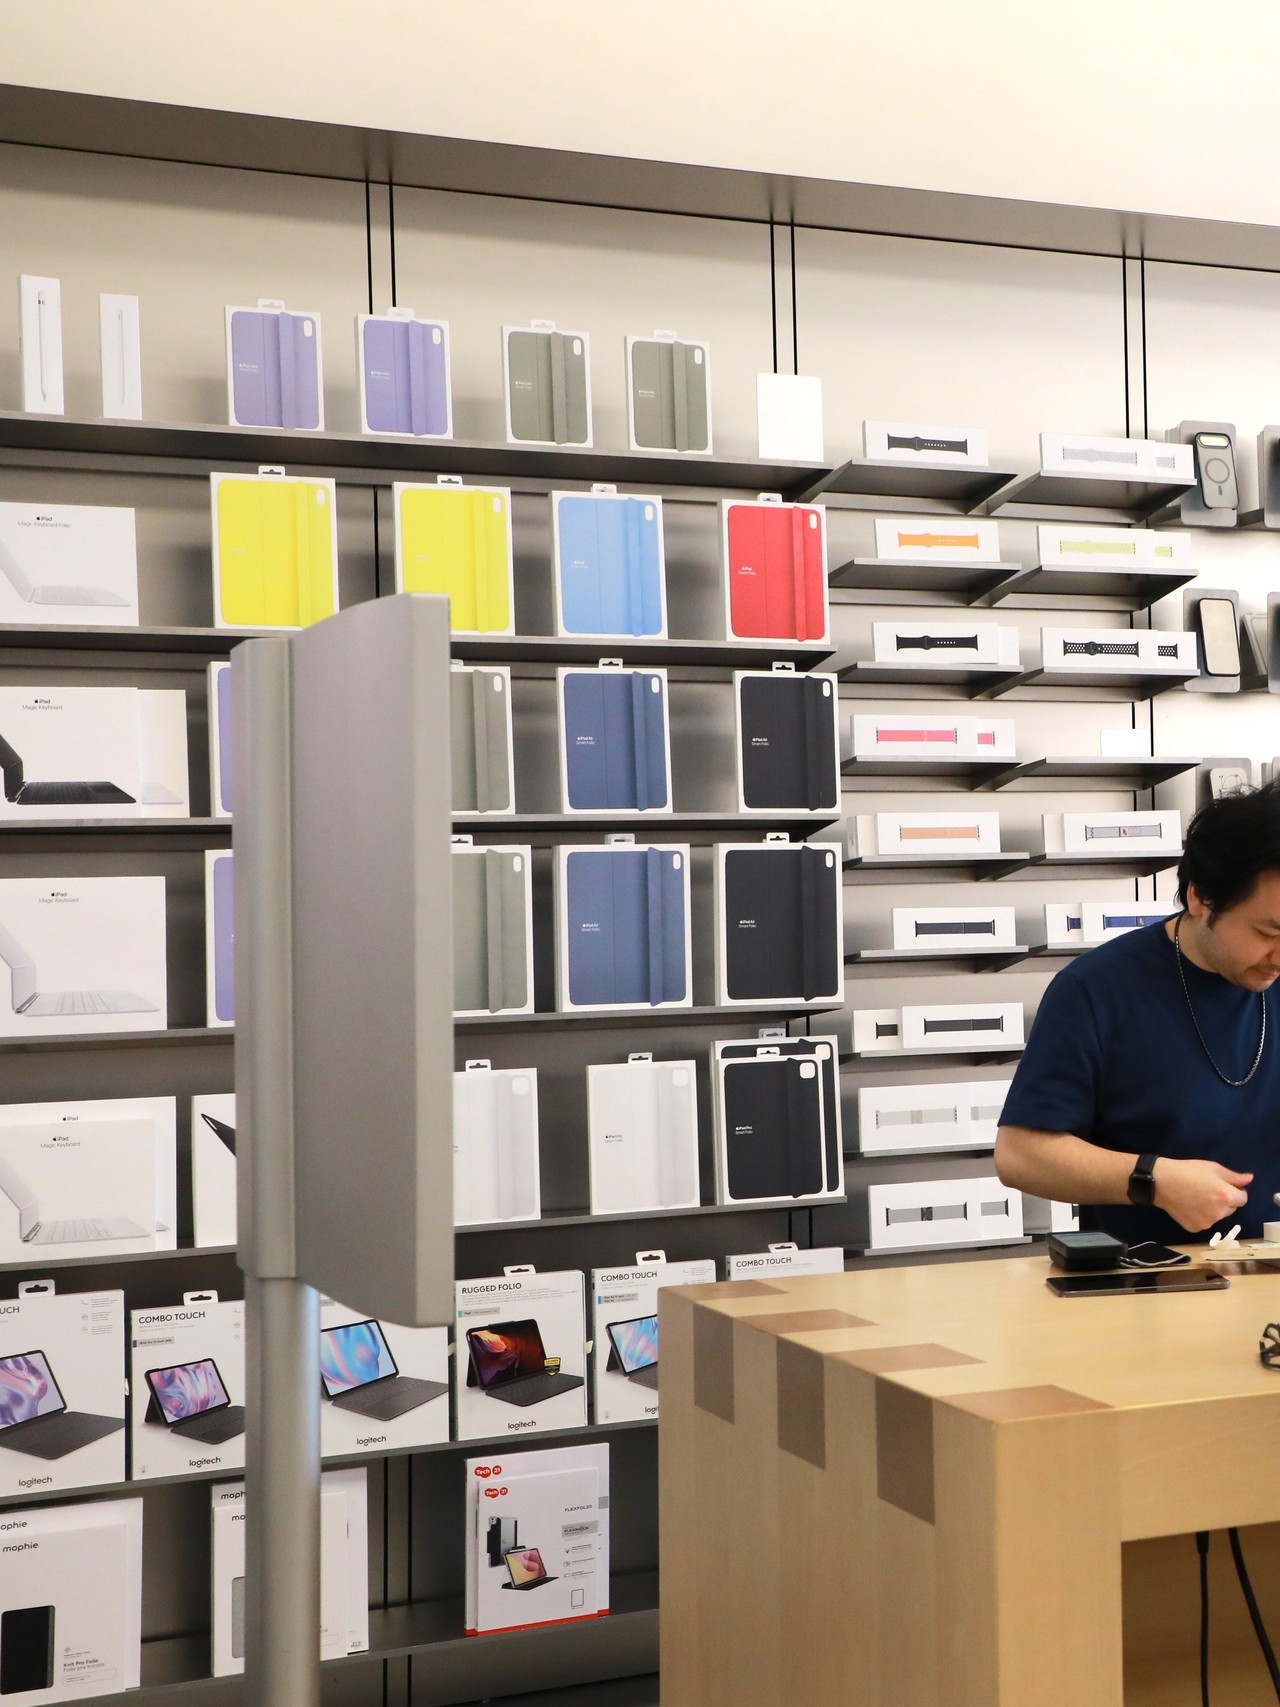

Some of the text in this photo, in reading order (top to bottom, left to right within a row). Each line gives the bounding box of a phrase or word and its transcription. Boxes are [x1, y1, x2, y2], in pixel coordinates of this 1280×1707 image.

[736, 1259, 764, 1268] COMBO
[601, 1271, 658, 1282] COMBO TOUCH
[462, 1283, 522, 1294] RUGGED FOLIO
[0, 1306, 20, 1314] UCH
[139, 1311, 206, 1324] COMBO TOUCH
[508, 1420, 536, 1430] logitech
[356, 1435, 387, 1446] logitech
[189, 1457, 221, 1468] logitech
[18, 1476, 52, 1488] logitech
[221, 1490, 246, 1499] moph
[0, 1521, 27, 1531] ophie
[3, 1542, 38, 1552] mophie
